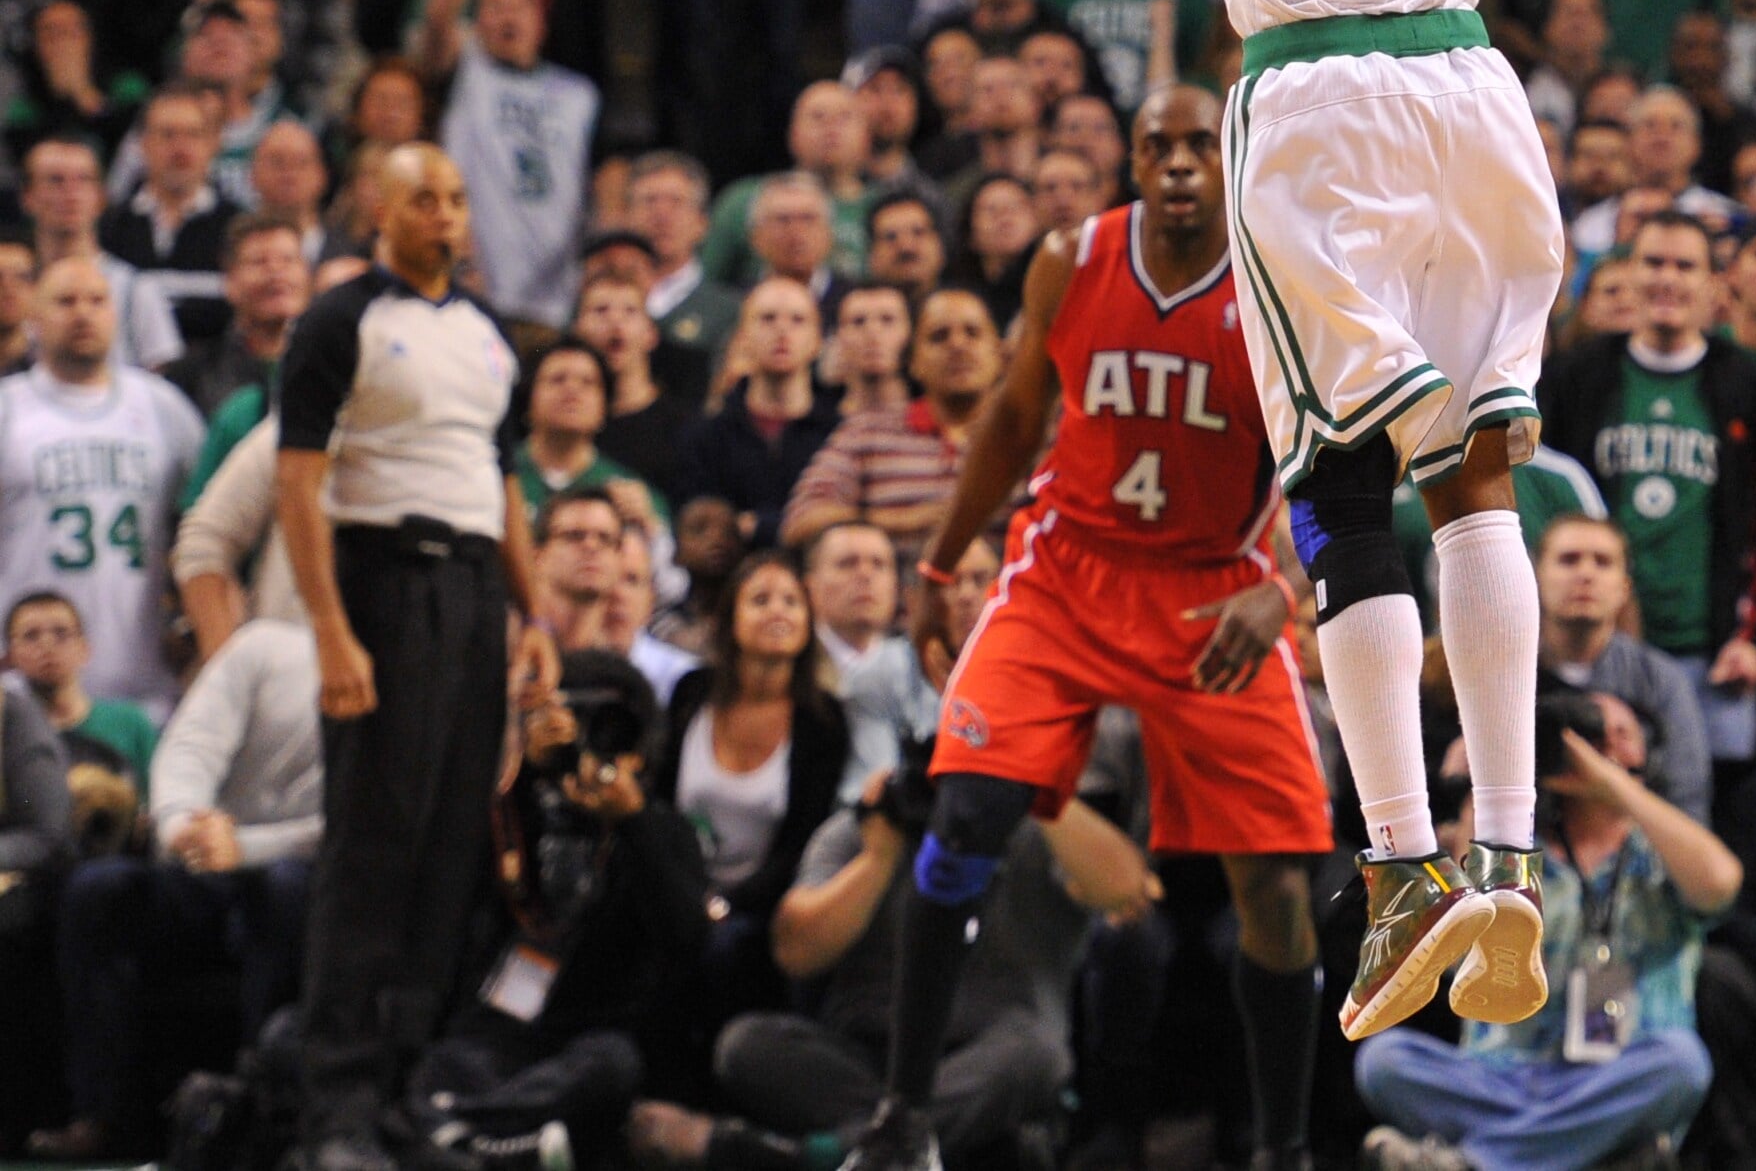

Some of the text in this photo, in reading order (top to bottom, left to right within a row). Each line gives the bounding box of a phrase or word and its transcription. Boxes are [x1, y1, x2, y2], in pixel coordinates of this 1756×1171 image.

[1083, 350, 1228, 432] ATL
[1111, 449, 1167, 521] 4
[1595, 424, 1720, 486] CELTICS
[50, 504, 143, 570] 34
